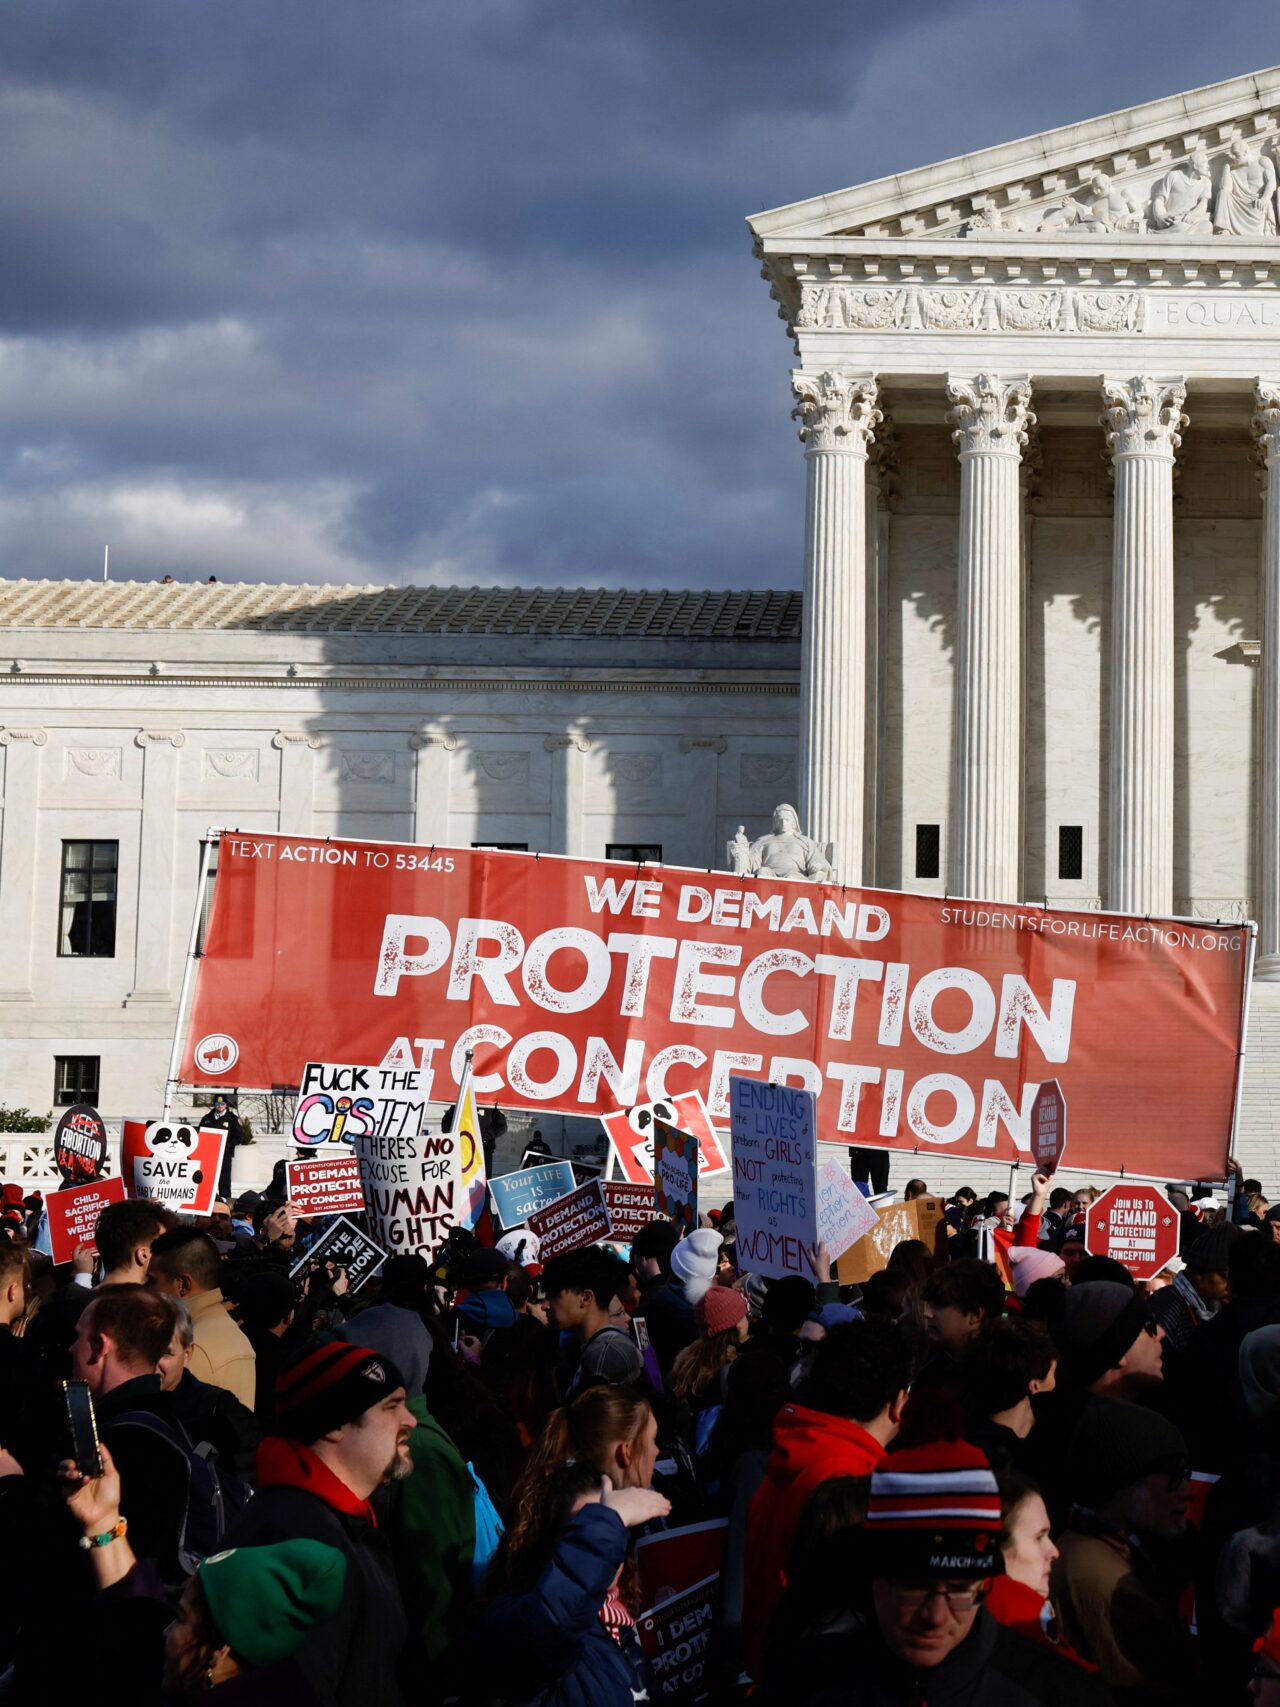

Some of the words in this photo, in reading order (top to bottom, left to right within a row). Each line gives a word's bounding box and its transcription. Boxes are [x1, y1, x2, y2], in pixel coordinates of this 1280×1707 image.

[1166, 301, 1276, 327] EQUAL
[229, 840, 276, 859] TEXT
[279, 844, 357, 867] ACTION
[363, 851, 390, 868] TO
[394, 853, 455, 873] 53445
[584, 875, 663, 918] WE
[676, 884, 891, 942] DEMAND
[373, 913, 1077, 1064] PROTECTION
[379, 1036, 446, 1070] AT
[302, 1063, 371, 1096] FUCK
[378, 1070, 421, 1091] THE
[738, 1081, 806, 1120] ENDING
[734, 1113, 749, 1126] the
[754, 1113, 798, 1141] LIVES
[60, 1127, 102, 1162] ABORTION
[424, 1137, 455, 1159] NO
[764, 1138, 802, 1166] GIRLS
[142, 1161, 189, 1178] SAVE
[158, 1178, 171, 1186] the
[299, 1172, 305, 1182] I
[309, 1166, 358, 1181] DEMAN
[360, 1158, 410, 1184] EXCUSE
[421, 1159, 452, 1182] FOR
[501, 1174, 535, 1193] Your
[536, 1168, 564, 1183] LIFE
[734, 1157, 767, 1182] NOT
[771, 1172, 805, 1193] protecting
[73, 1193, 100, 1206] CHILD
[136, 1185, 153, 1199] BABY
[156, 1186, 195, 1200] HUMANS
[291, 1179, 361, 1196] PROTECTI
[310, 1191, 363, 1206] CONCEPTI
[362, 1180, 455, 1217] HUMAN
[530, 1185, 545, 1198] IS
[614, 1193, 655, 1206] DEMA
[65, 1199, 110, 1217] SACRIFICE
[538, 1222, 544, 1232] I
[546, 1194, 595, 1228] DEMAND
[607, 1207, 673, 1222] ROTECTIO
[757, 1187, 807, 1220] RIGHTS
[66, 1221, 100, 1236] WELC
[74, 1216, 83, 1225] IS
[368, 1213, 455, 1247] RIGHTS
[767, 1215, 779, 1227] as
[1109, 1209, 1157, 1227] DEMAND
[79, 1231, 96, 1242] HE
[541, 1247, 553, 1261] AT
[552, 1218, 607, 1253] CONCEPTION
[735, 1226, 817, 1278] WOMEN
[669, 1602, 714, 1641] DEM
